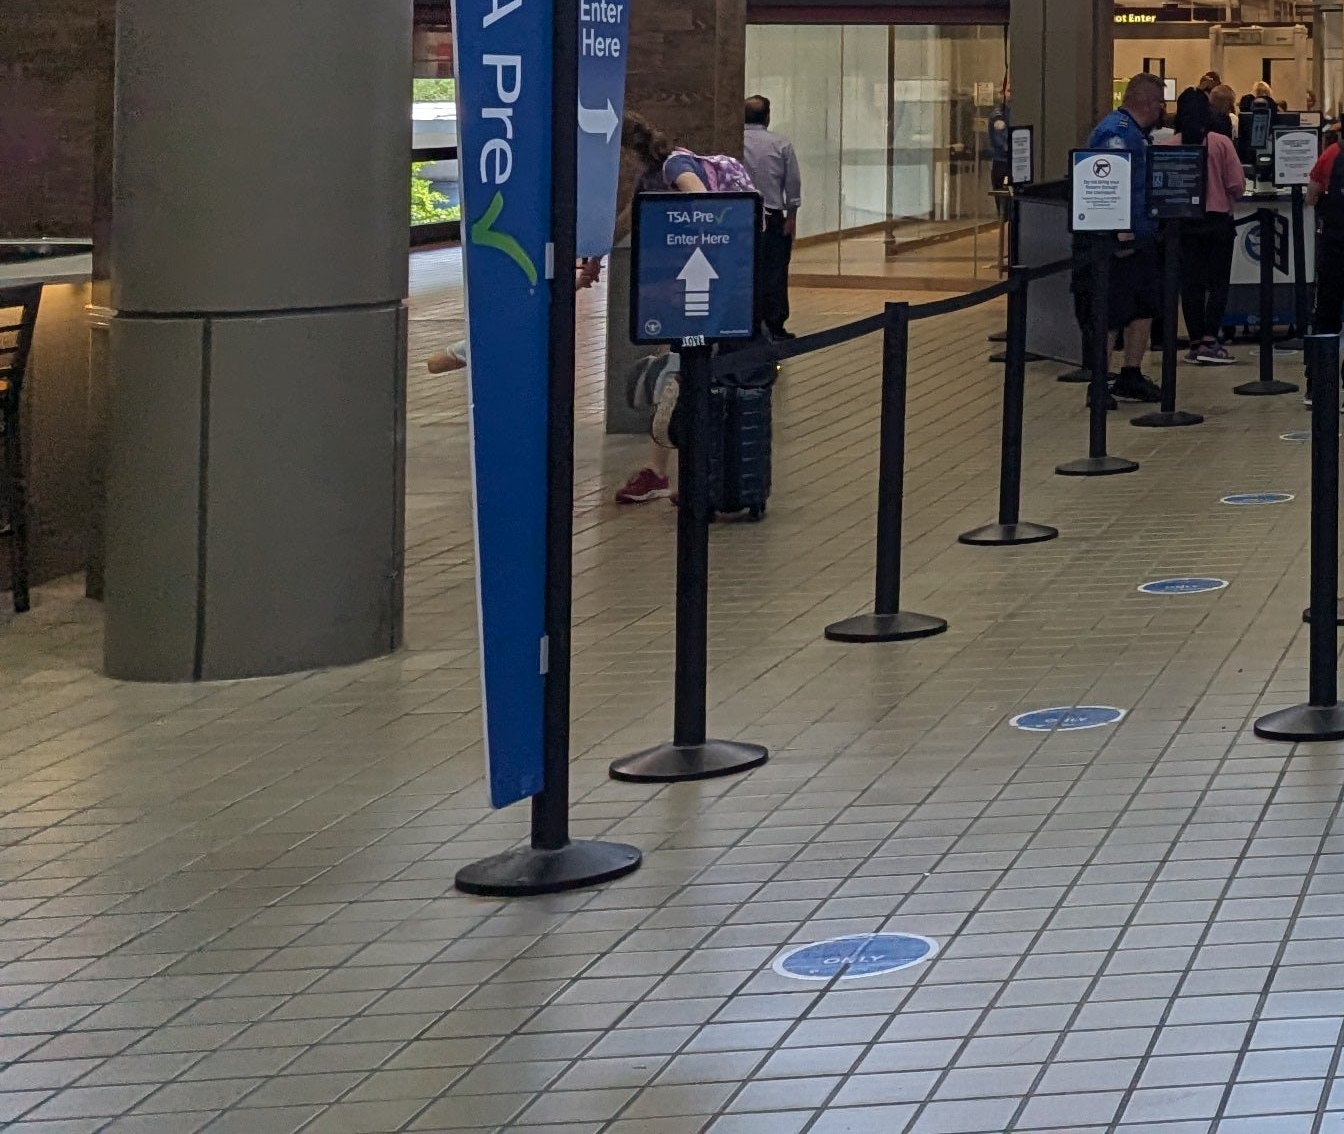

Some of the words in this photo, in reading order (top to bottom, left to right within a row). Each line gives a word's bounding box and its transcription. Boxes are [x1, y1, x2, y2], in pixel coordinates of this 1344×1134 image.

[1114, 13, 1126, 23] ot
[1128, 13, 1157, 23] Enter
[582, 27, 620, 58] Here
[480, 54, 522, 185] Pre
[666, 211, 690, 222] TSA
[693, 211, 714, 222] Pre
[666, 233, 698, 245] Enter
[701, 233, 730, 245] Here
[823, 954, 886, 965] ONLY
